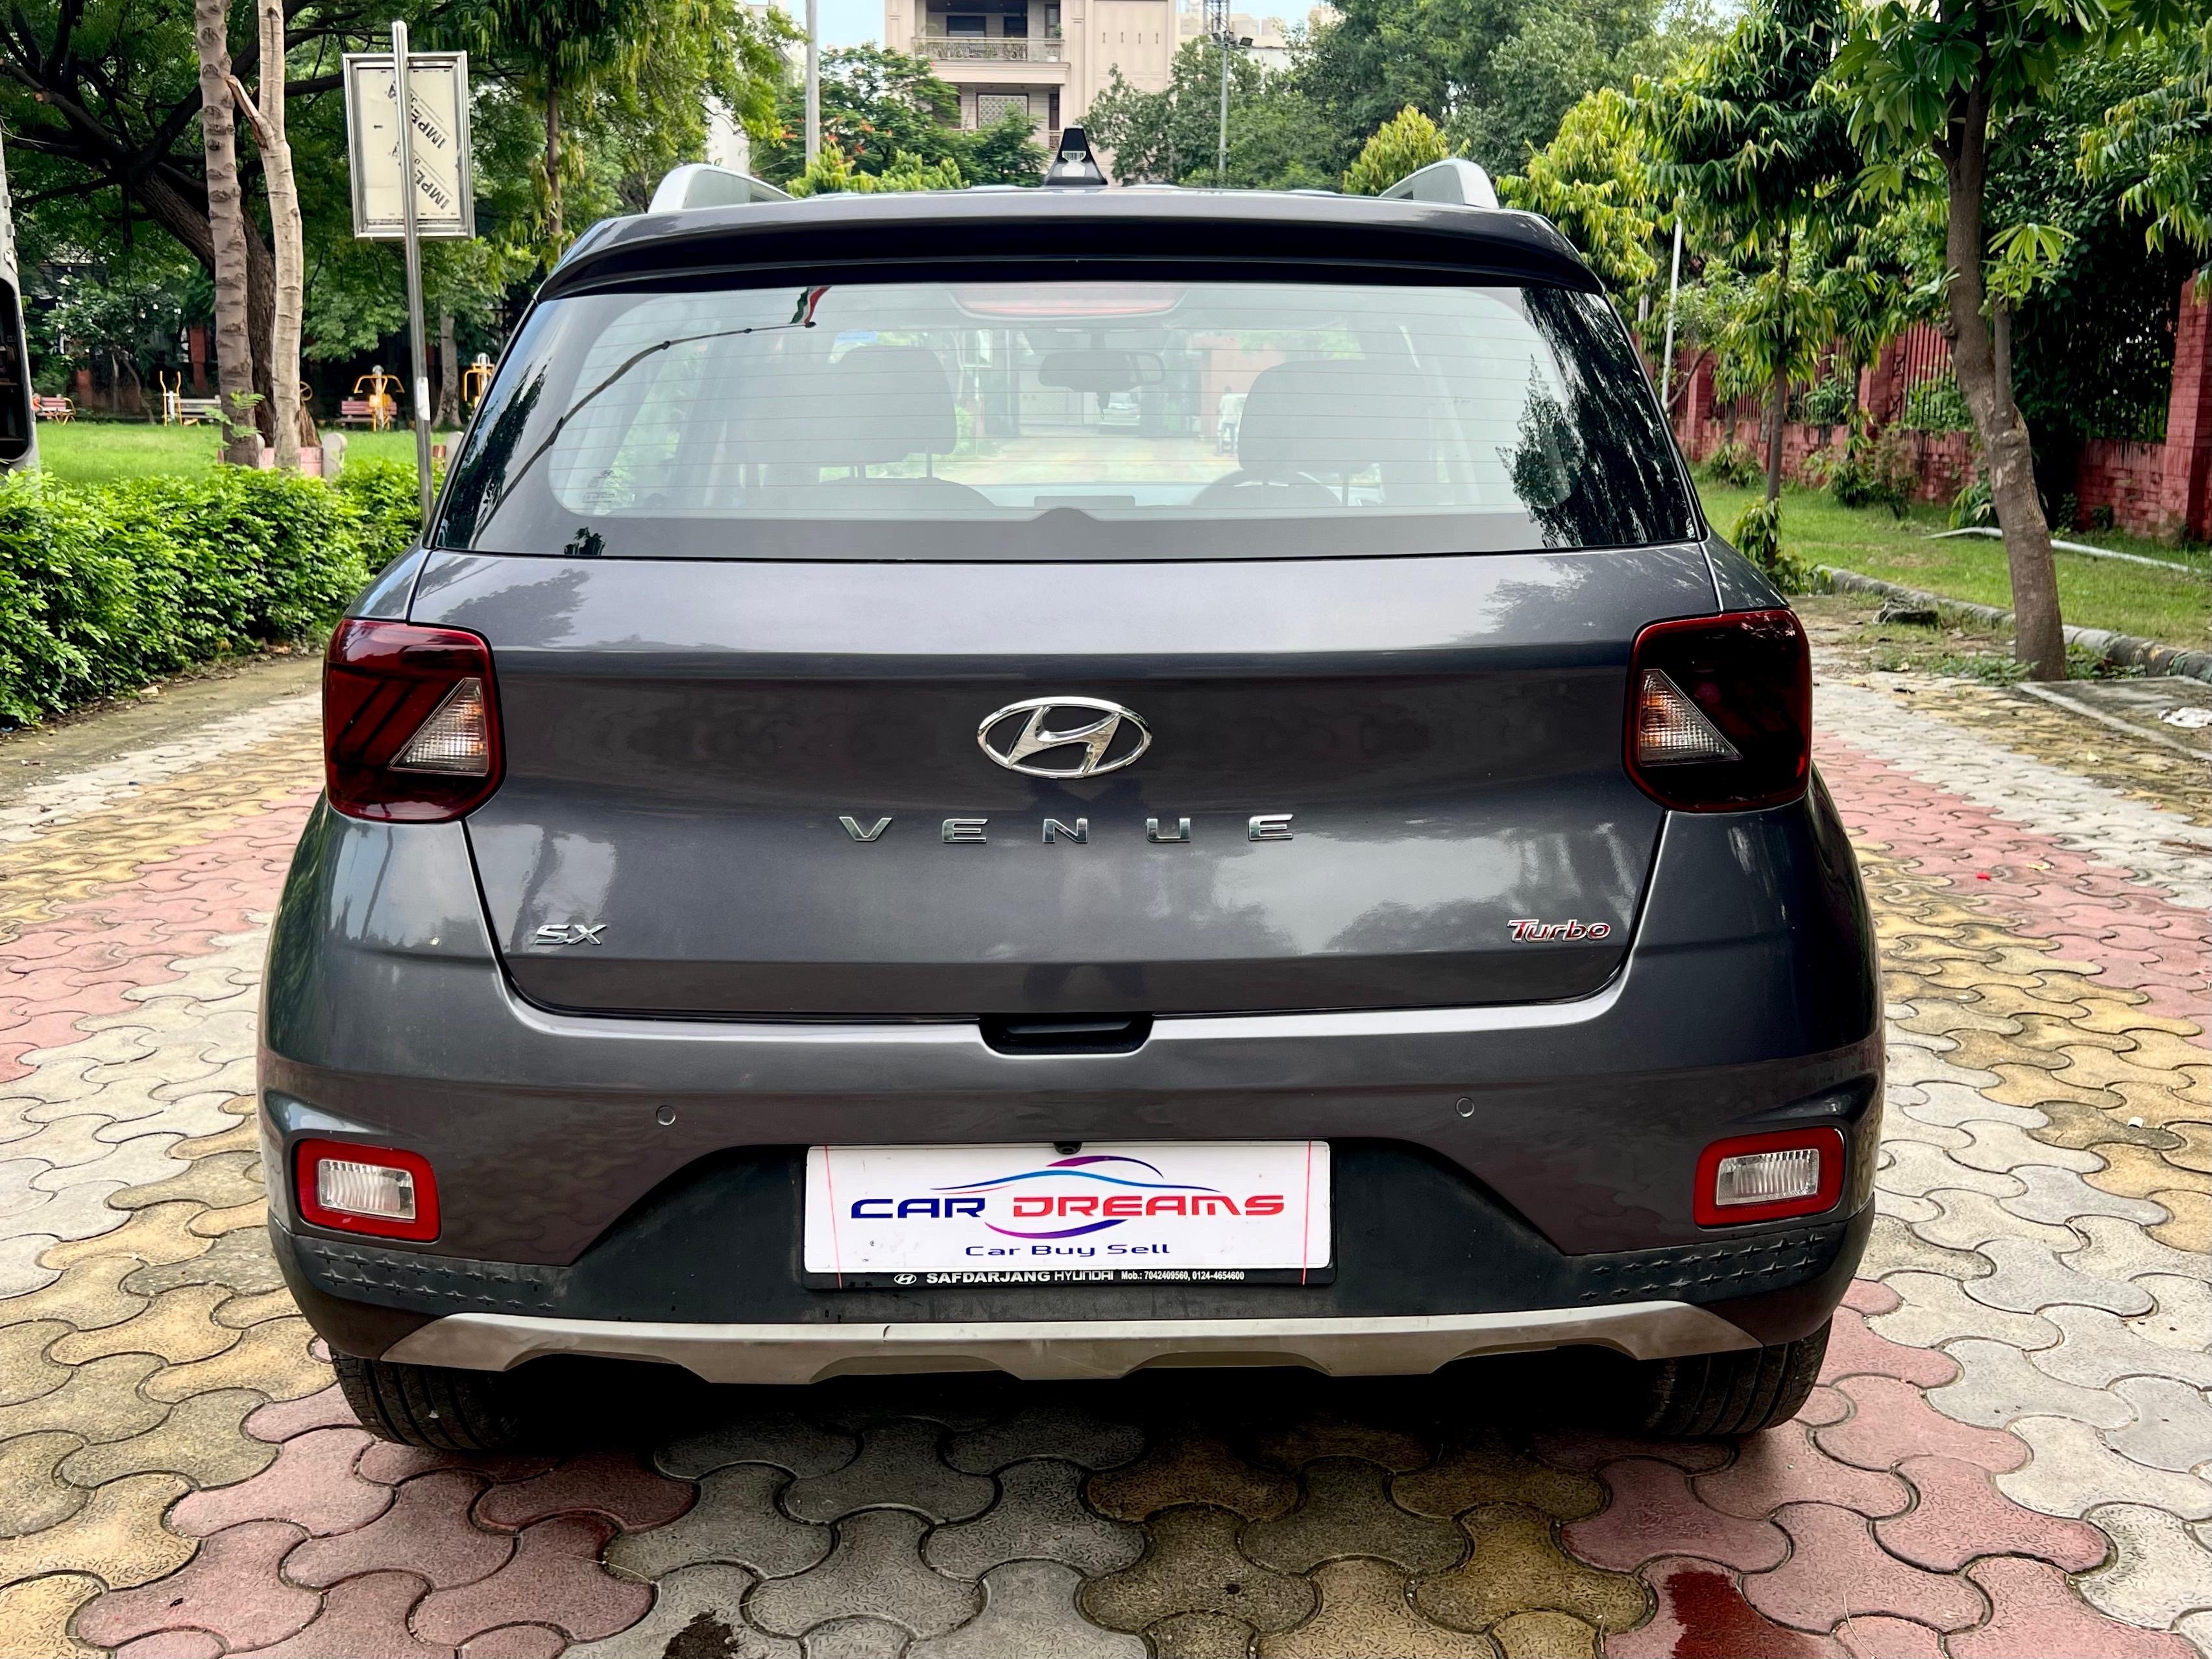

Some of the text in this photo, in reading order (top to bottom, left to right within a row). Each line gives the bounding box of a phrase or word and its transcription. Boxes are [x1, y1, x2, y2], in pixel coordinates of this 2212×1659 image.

[838, 813, 1294, 843] VENUE
[535, 925, 608, 945] SX
[1507, 919, 1611, 943] Turbo
[851, 1195, 1285, 1218] CAR DREAMS
[966, 1244, 1171, 1257] Car Buy Sell
[926, 1270, 1051, 1284] SAFDARJANG
[1054, 1270, 1114, 1281] HYUNDAI
[1192, 1270, 1245, 1281] 0124-4654600
